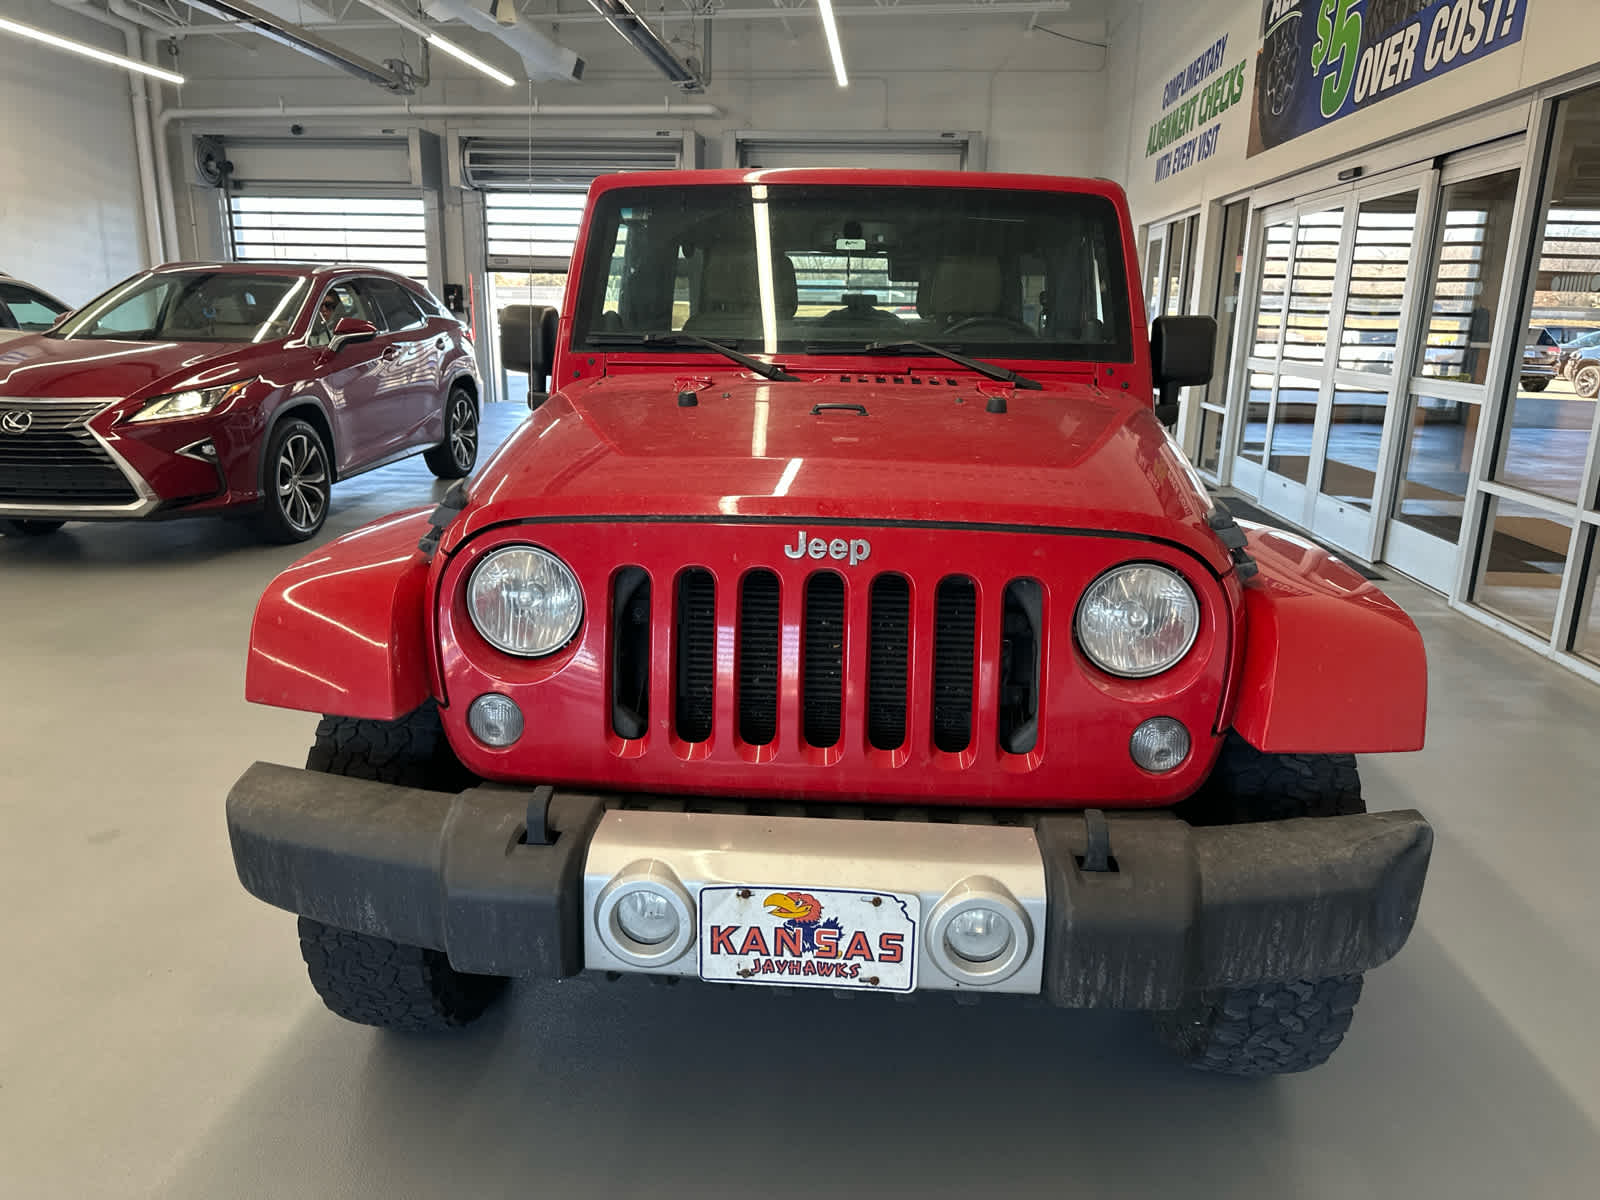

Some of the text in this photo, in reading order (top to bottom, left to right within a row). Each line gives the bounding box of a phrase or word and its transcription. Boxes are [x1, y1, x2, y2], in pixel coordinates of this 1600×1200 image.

[1162, 32, 1229, 110] COMPLIMENTARY
[1311, 0, 1517, 118] $5 OVER COST!
[1145, 58, 1247, 158] ALIGNMENT CHECKS
[1155, 123, 1221, 184] WITH EVERY VISIT
[784, 530, 871, 566] Jeep
[710, 925, 905, 963] KANSAS
[751, 958, 861, 980] JAYHAWKS
